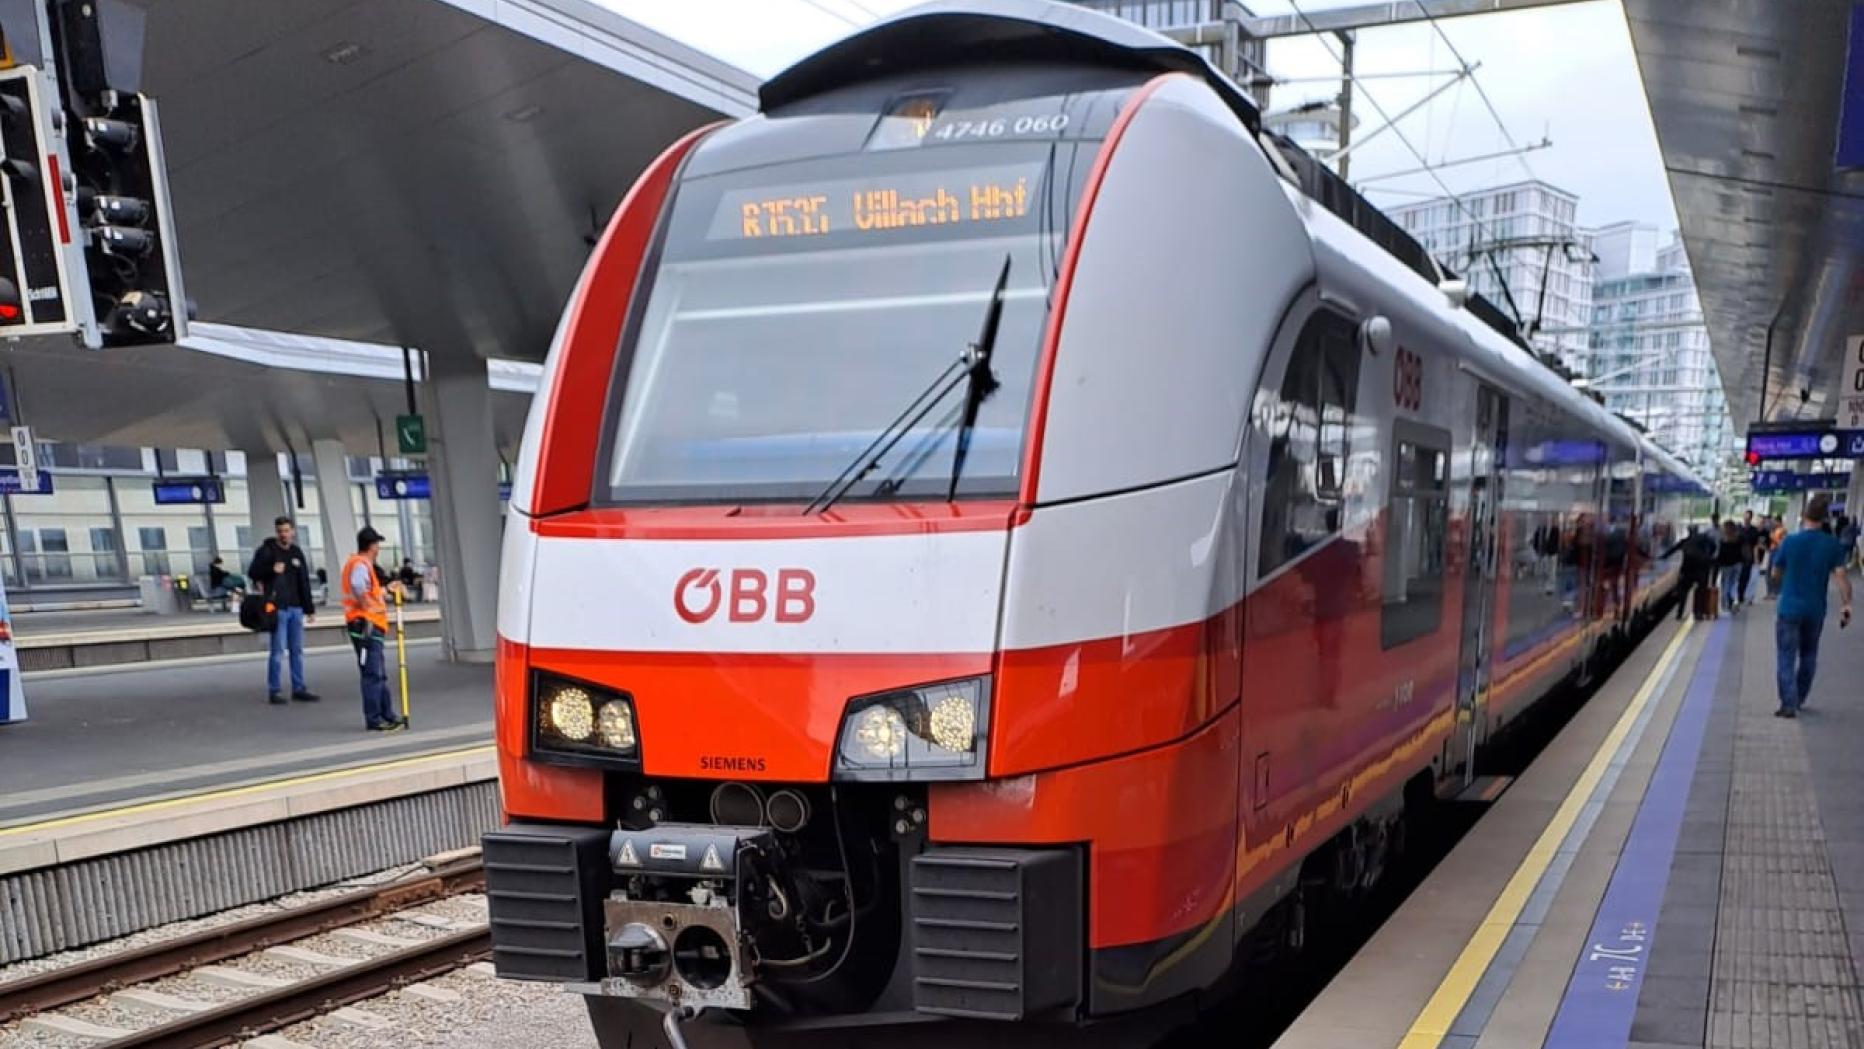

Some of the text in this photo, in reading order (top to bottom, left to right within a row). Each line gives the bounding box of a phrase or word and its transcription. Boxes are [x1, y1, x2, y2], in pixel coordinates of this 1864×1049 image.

[935, 114, 1070, 139] 4746 060
[854, 188, 960, 230] Villach
[970, 177, 1026, 221] Hbf
[674, 567, 816, 624] ÖBB
[700, 756, 767, 772] SIEMENS
